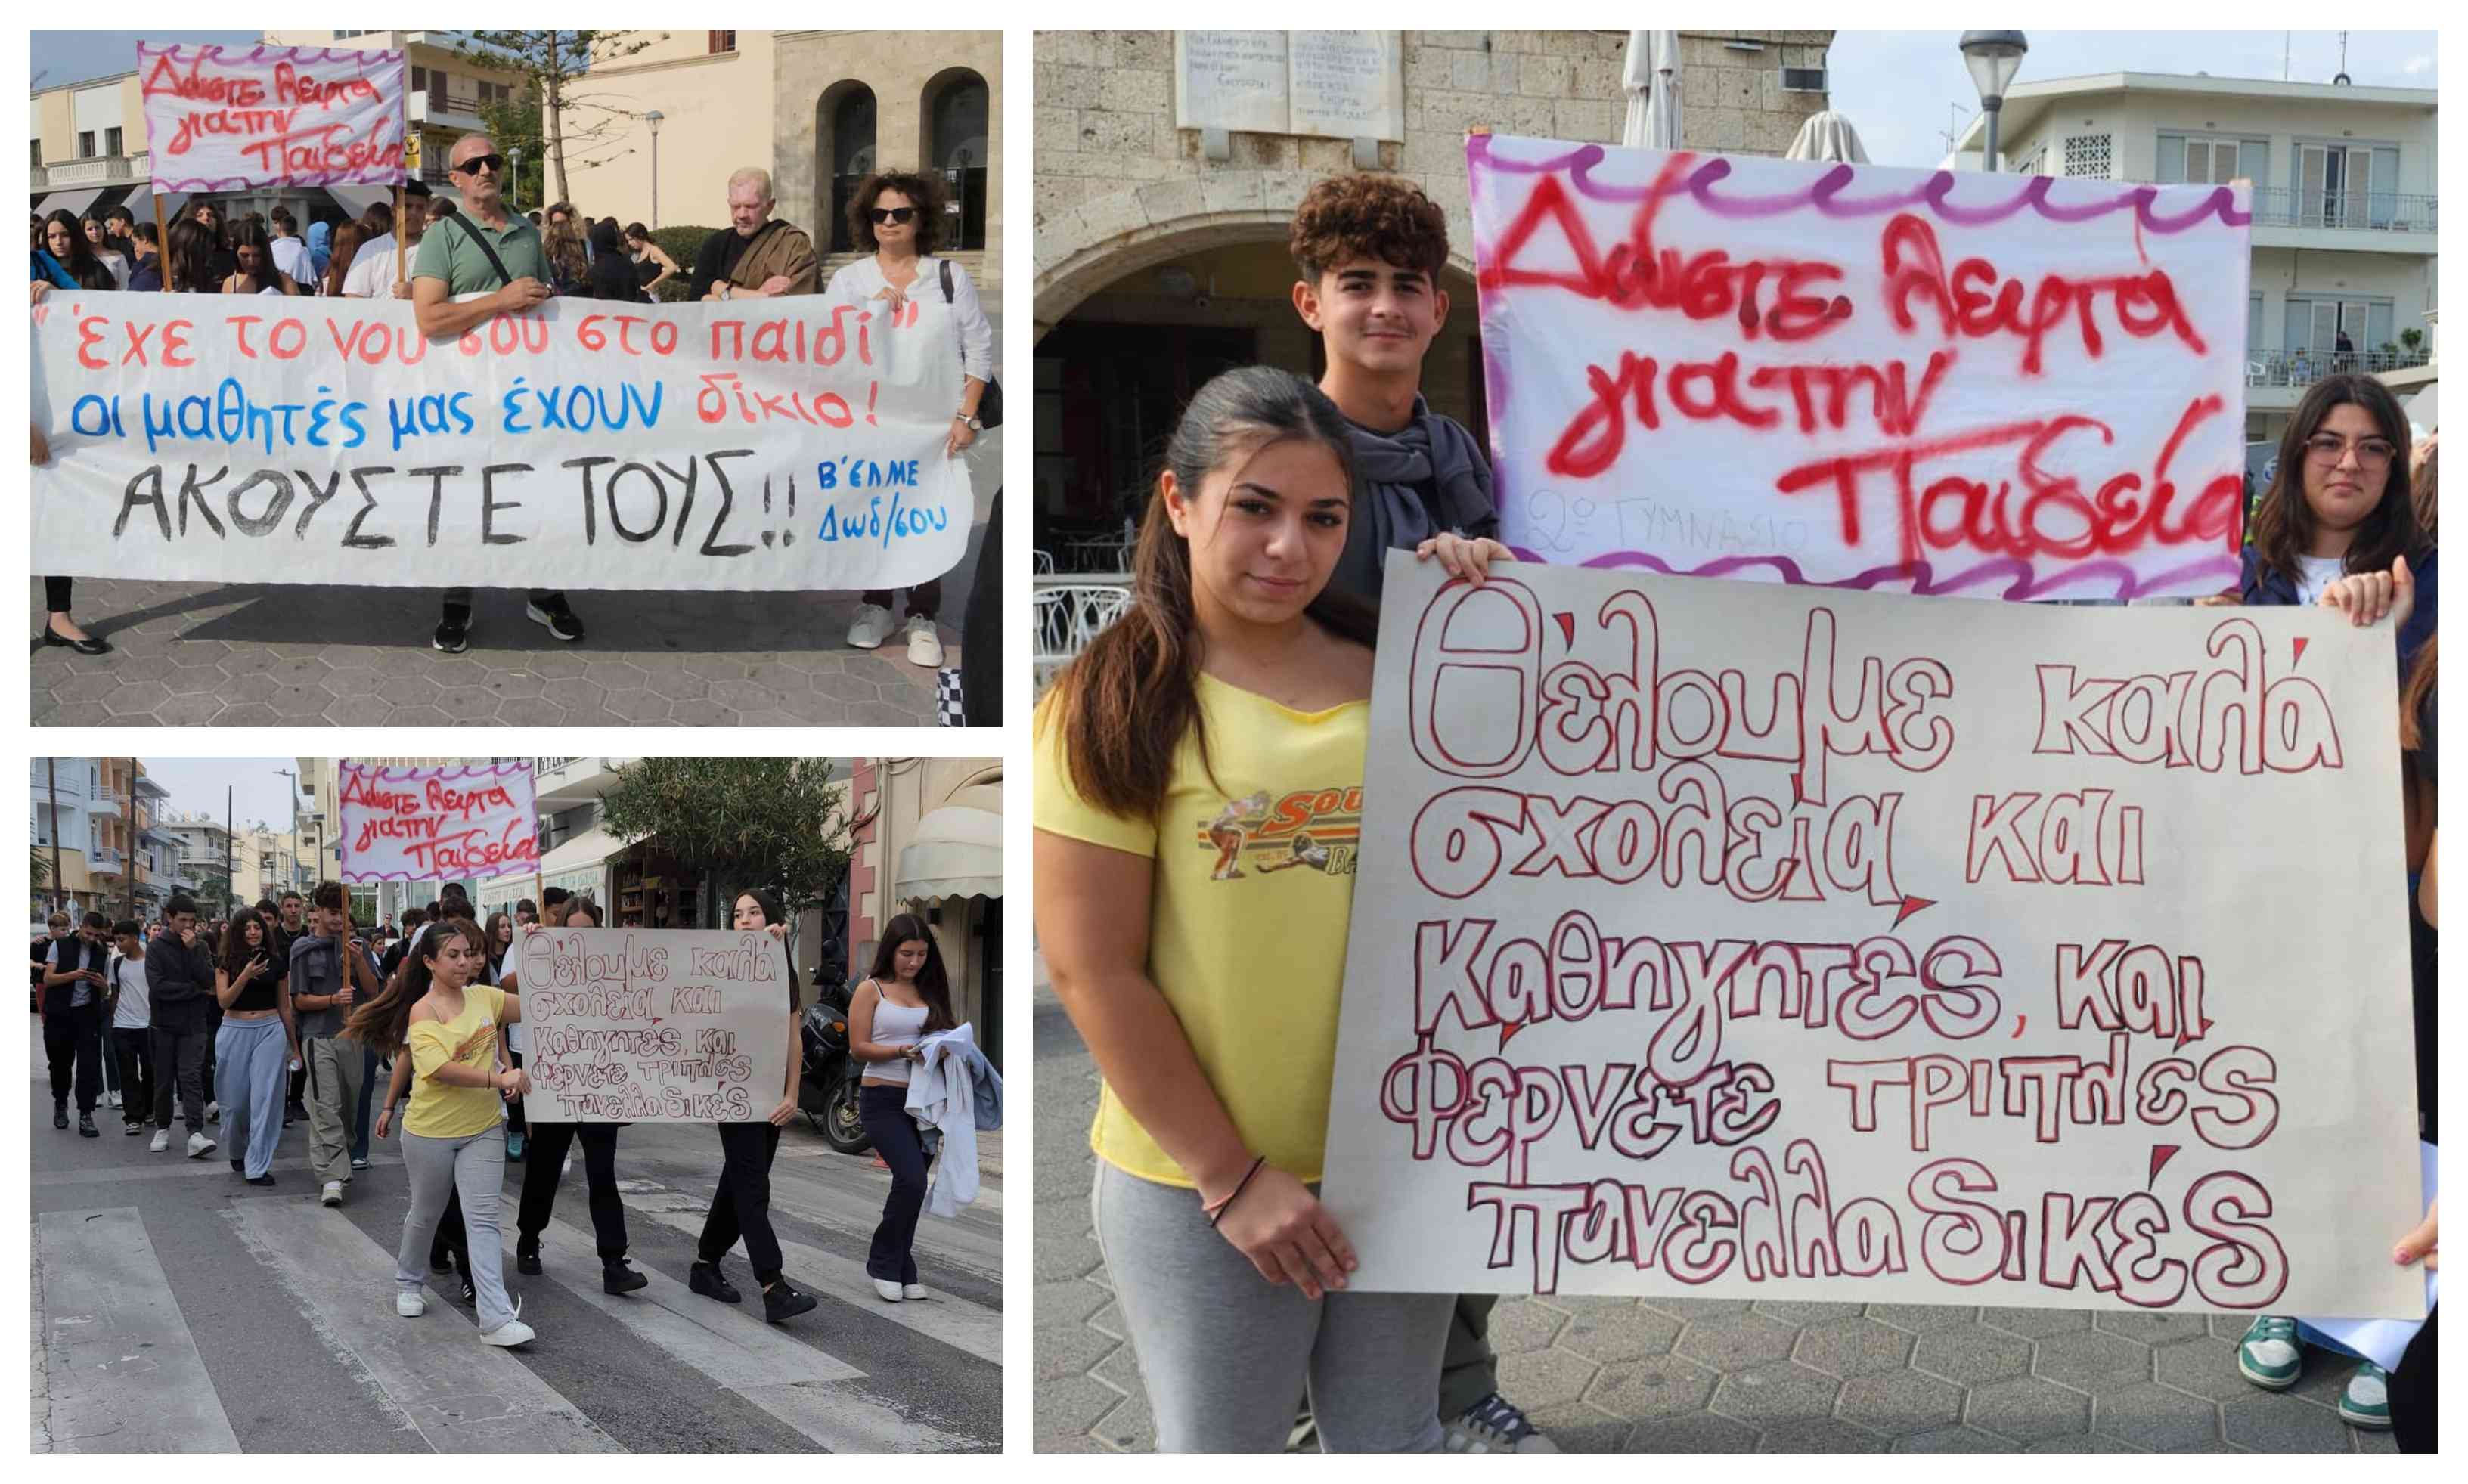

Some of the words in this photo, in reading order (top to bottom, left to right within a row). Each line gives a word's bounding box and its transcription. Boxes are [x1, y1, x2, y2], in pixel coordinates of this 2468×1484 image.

[226, 315, 307, 358] το
[327, 316, 427, 365] νου
[577, 315, 678, 355] στο
[72, 394, 126, 438] οι
[142, 377, 369, 455] μαθητές
[389, 392, 475, 451] μας
[503, 376, 662, 434] έχουν
[111, 463, 535, 550] ΑΚΟΥΣΤΕ
[2034, 618, 2344, 773] καλά
[1966, 786, 2144, 886] και
[690, 934, 777, 982] καλά
[2057, 939, 2208, 1040] και
[671, 984, 722, 1014] και
[695, 1027, 736, 1055] και
